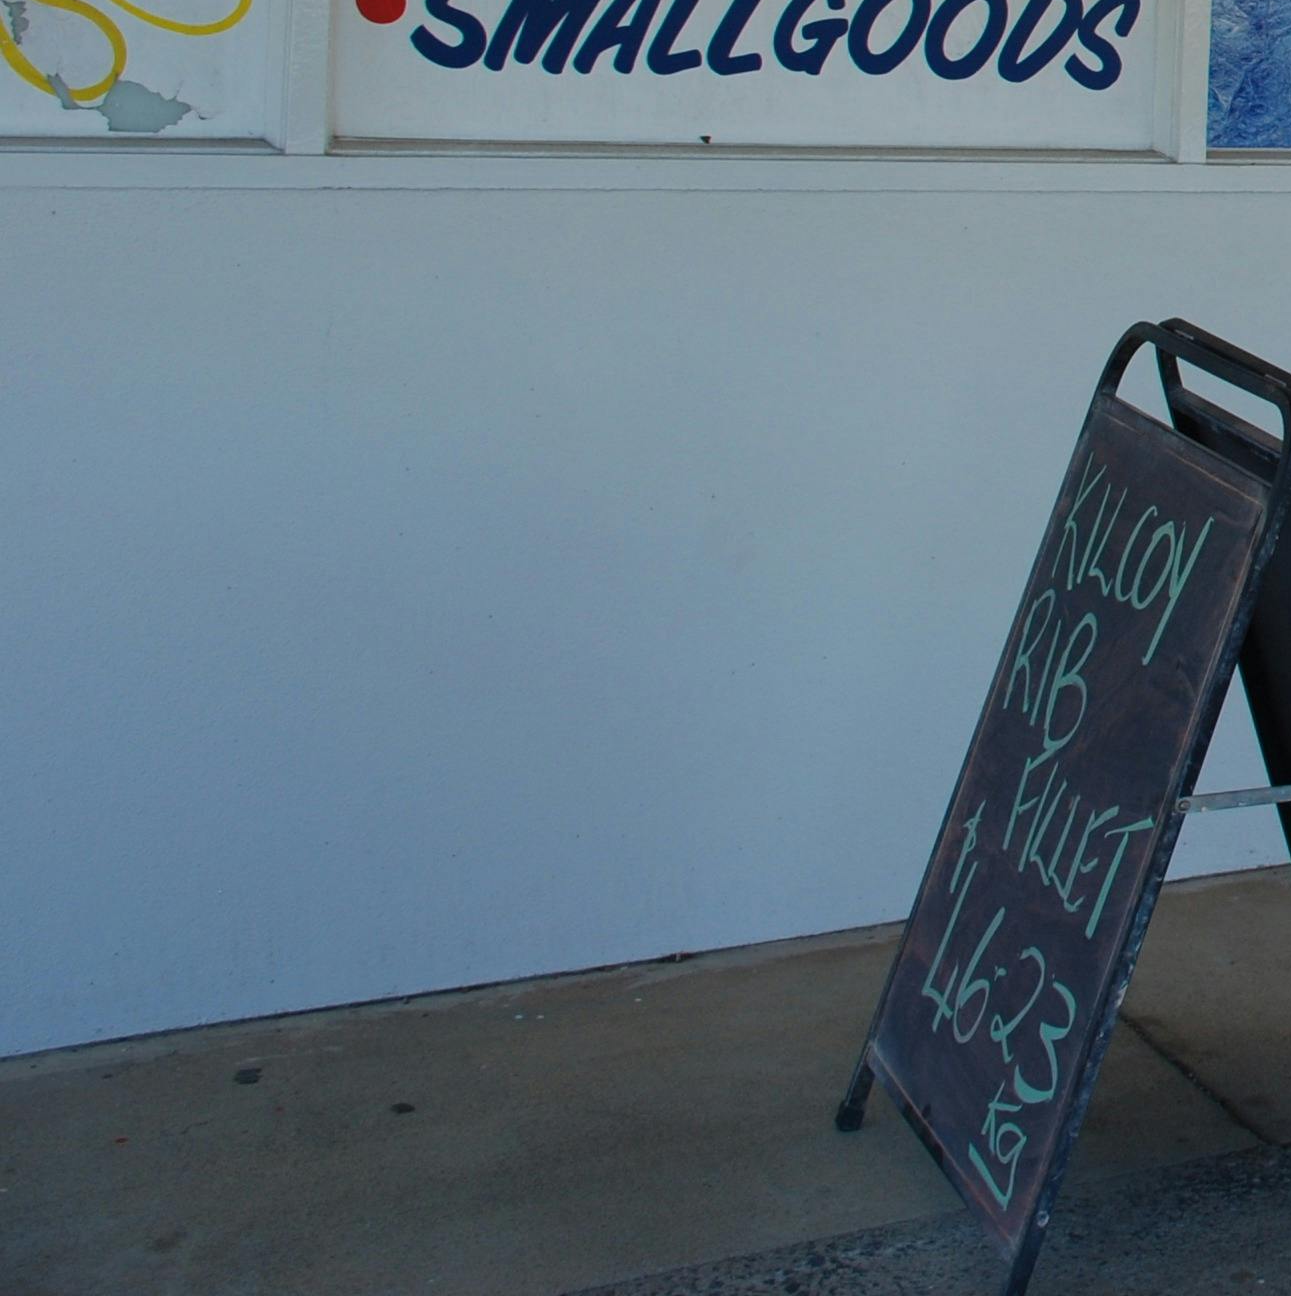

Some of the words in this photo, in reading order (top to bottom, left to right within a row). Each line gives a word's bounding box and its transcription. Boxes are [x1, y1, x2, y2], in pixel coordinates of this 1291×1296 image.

[1051, 450, 1215, 667] KILCOY
[1002, 588, 1099, 755] RIB
[1001, 746, 1155, 940] FILLET
